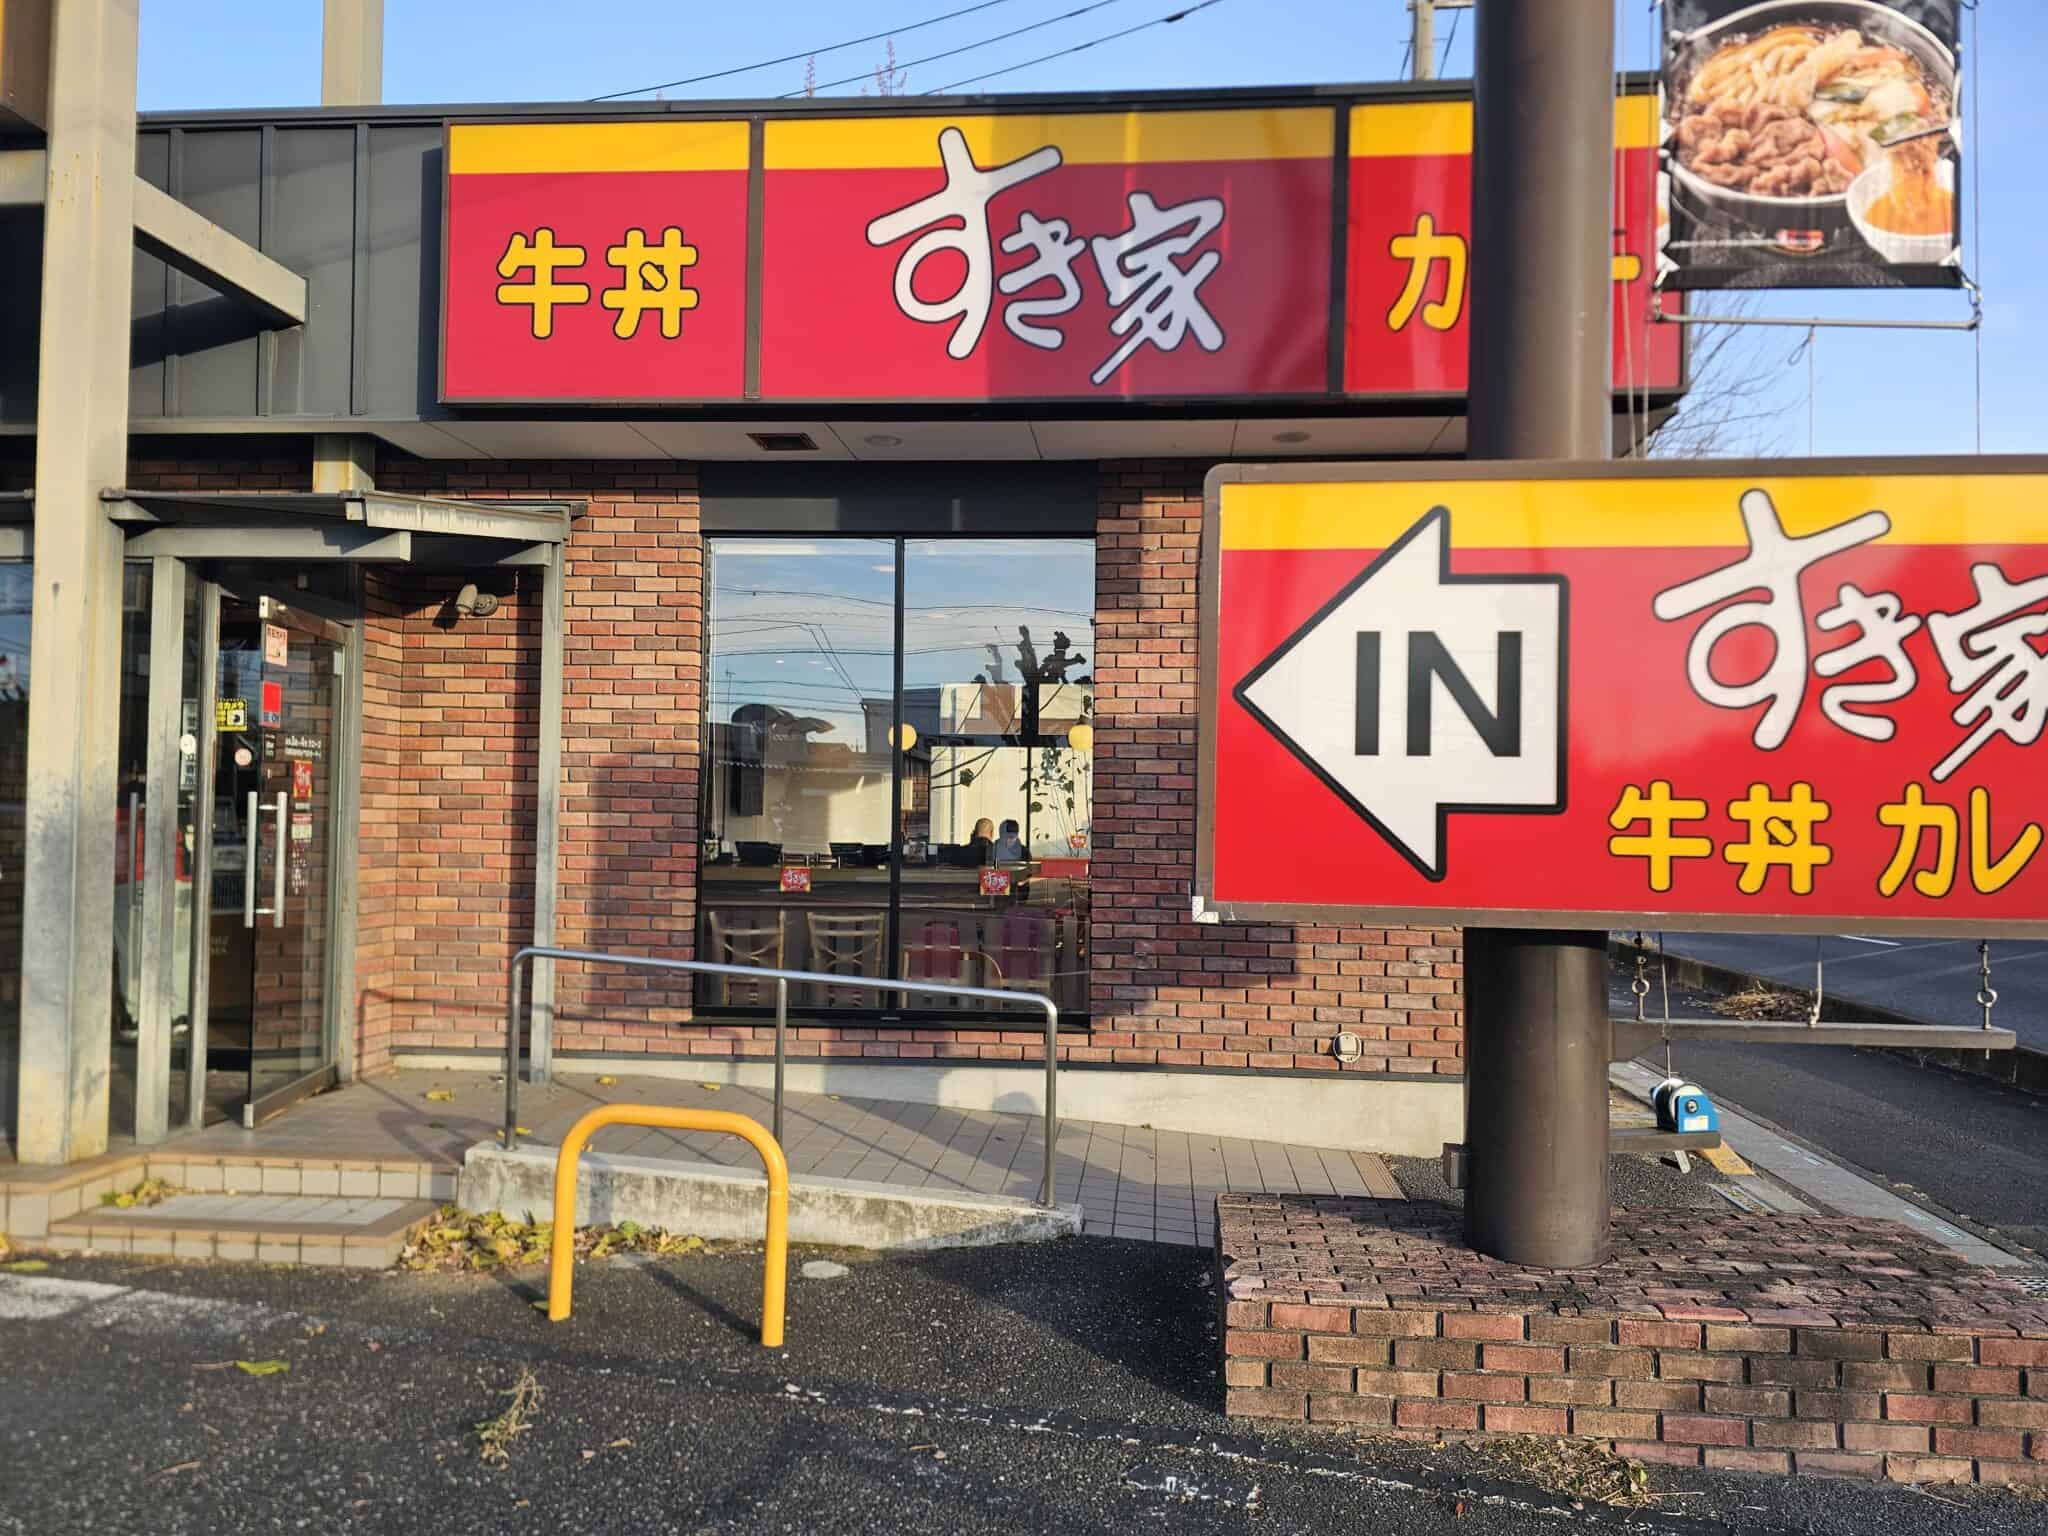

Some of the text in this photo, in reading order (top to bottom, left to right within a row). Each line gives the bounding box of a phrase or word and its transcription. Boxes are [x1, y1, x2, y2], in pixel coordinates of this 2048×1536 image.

[496, 226, 699, 340] 牛丼
[866, 126, 1225, 385] すき家
[1354, 630, 1523, 758] IN
[1653, 488, 2048, 783] すき家
[1608, 779, 1833, 895] 牛丼
